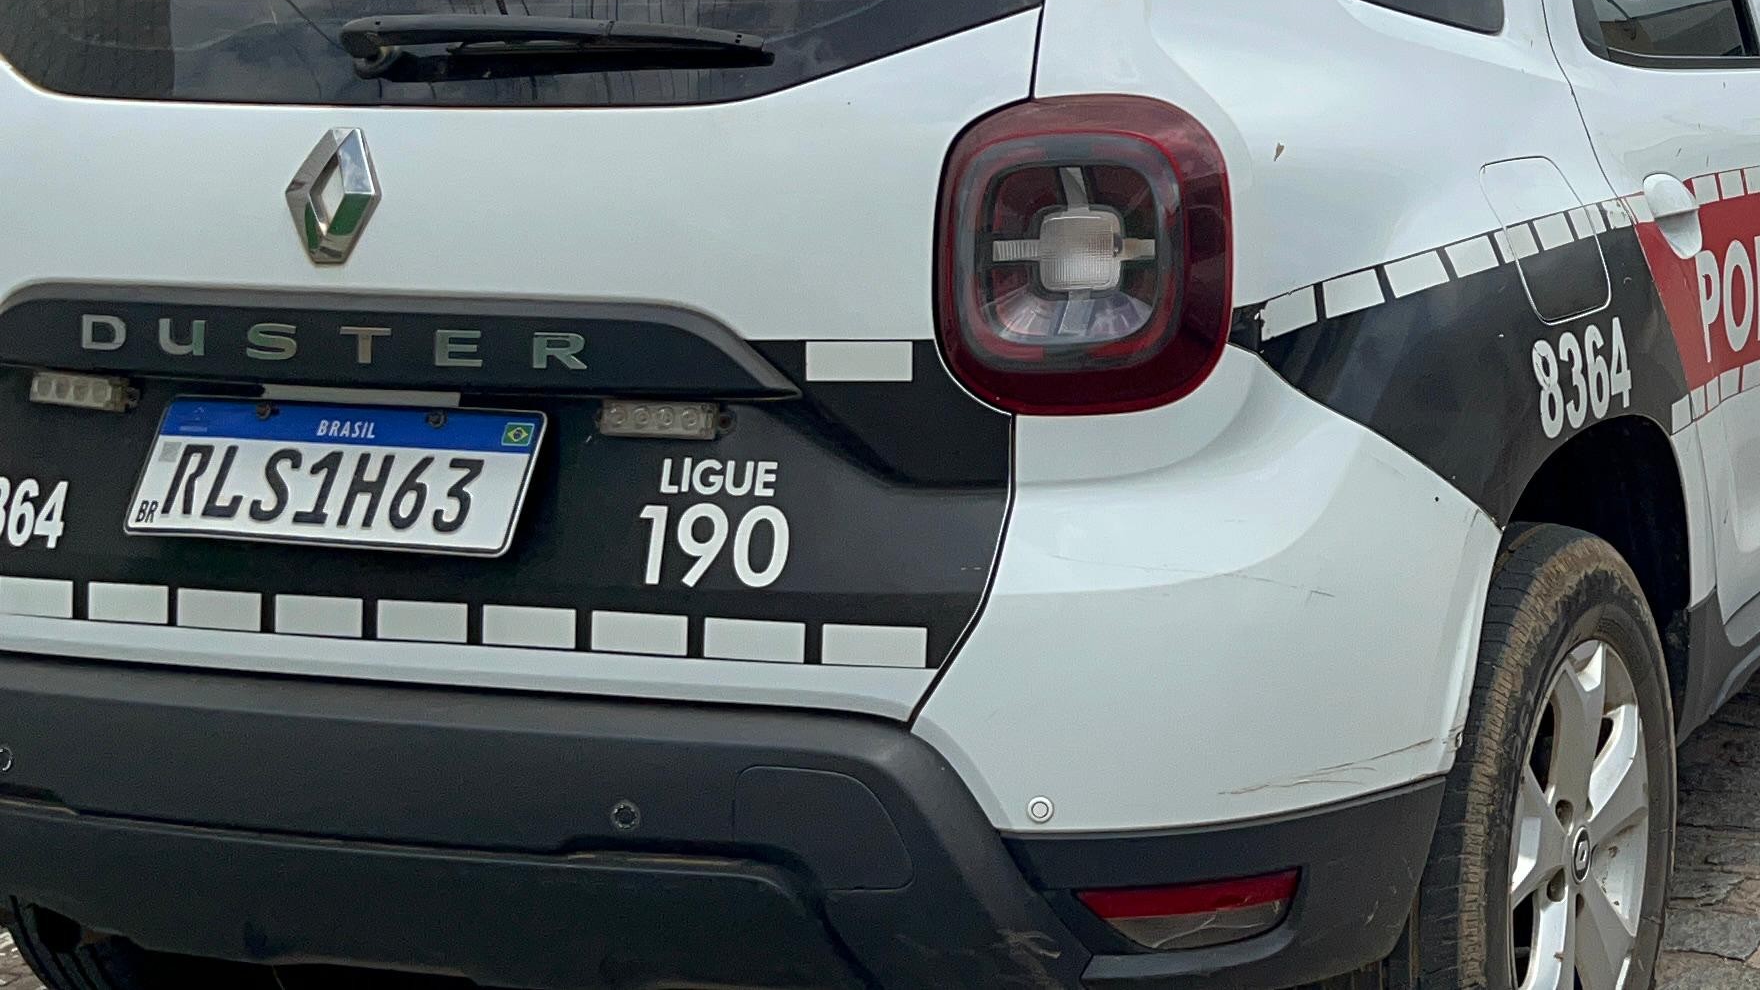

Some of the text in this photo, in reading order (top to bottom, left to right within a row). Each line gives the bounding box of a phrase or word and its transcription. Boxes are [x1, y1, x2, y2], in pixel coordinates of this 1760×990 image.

[80, 313, 588, 370] DUSTER
[1532, 316, 1632, 439] 8364
[316, 419, 377, 439] BRASIL
[160, 444, 485, 533] RLS1H63
[660, 457, 778, 497] LIGUE
[135, 500, 159, 524] BR
[639, 502, 790, 588] 190
